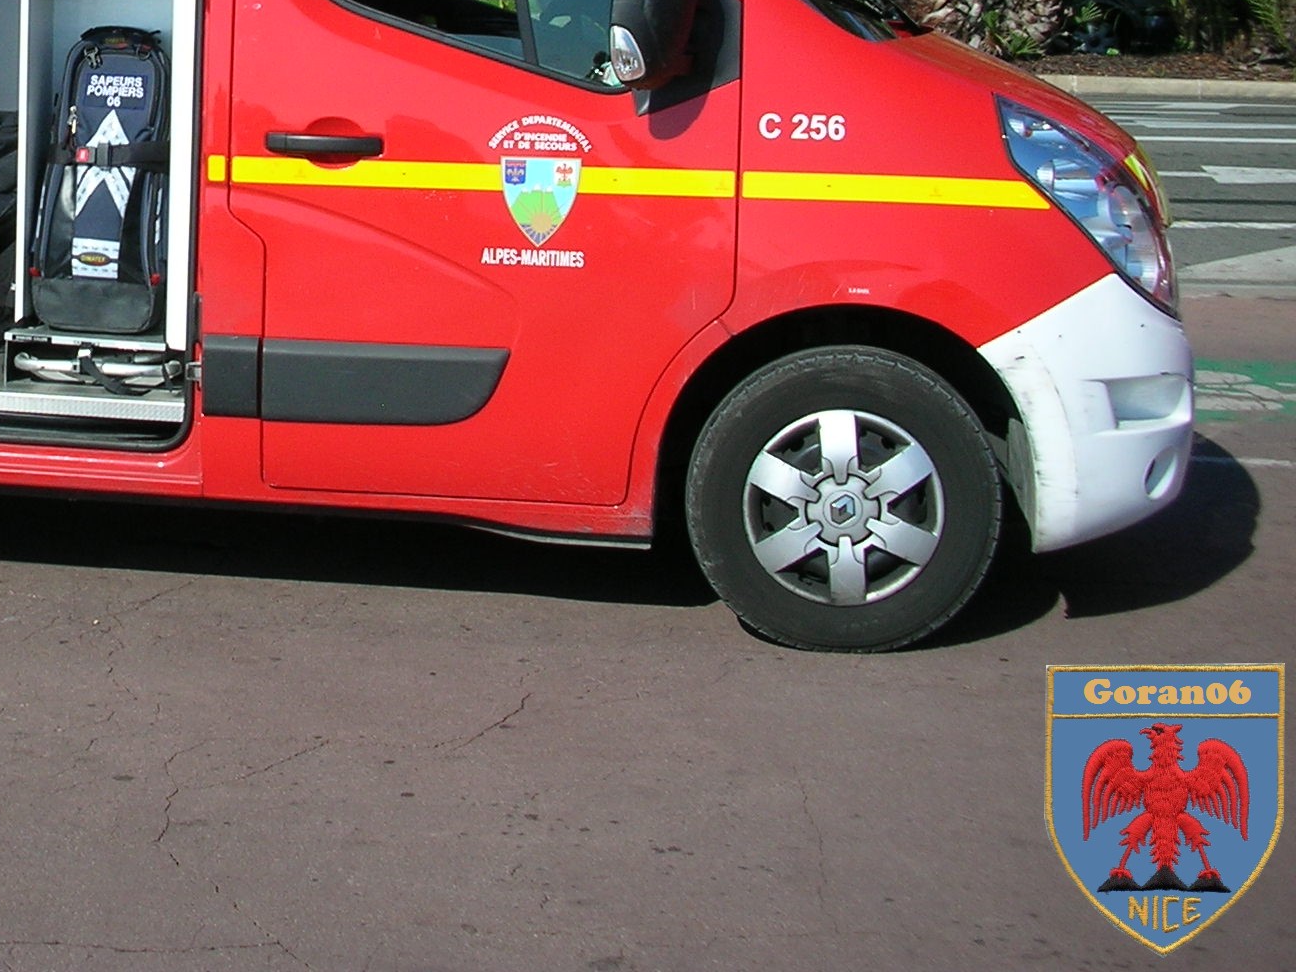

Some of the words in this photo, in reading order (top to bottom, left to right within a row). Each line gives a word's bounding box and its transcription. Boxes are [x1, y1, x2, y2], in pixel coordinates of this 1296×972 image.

[90, 74, 143, 88] SAPEURS
[86, 84, 144, 98] POMPIERS
[106, 96, 121, 107] 06
[758, 112, 782, 139] C
[790, 113, 846, 141] 256
[488, 120, 520, 149] SERVICE
[521, 115, 592, 153] DEPARTEMENTAL
[514, 131, 568, 143] D'INCENDIE
[503, 140, 515, 149] ET
[518, 140, 531, 150] DE
[534, 141, 578, 152] SECOURS
[480, 247, 585, 269] ALPES-MARITIMES
